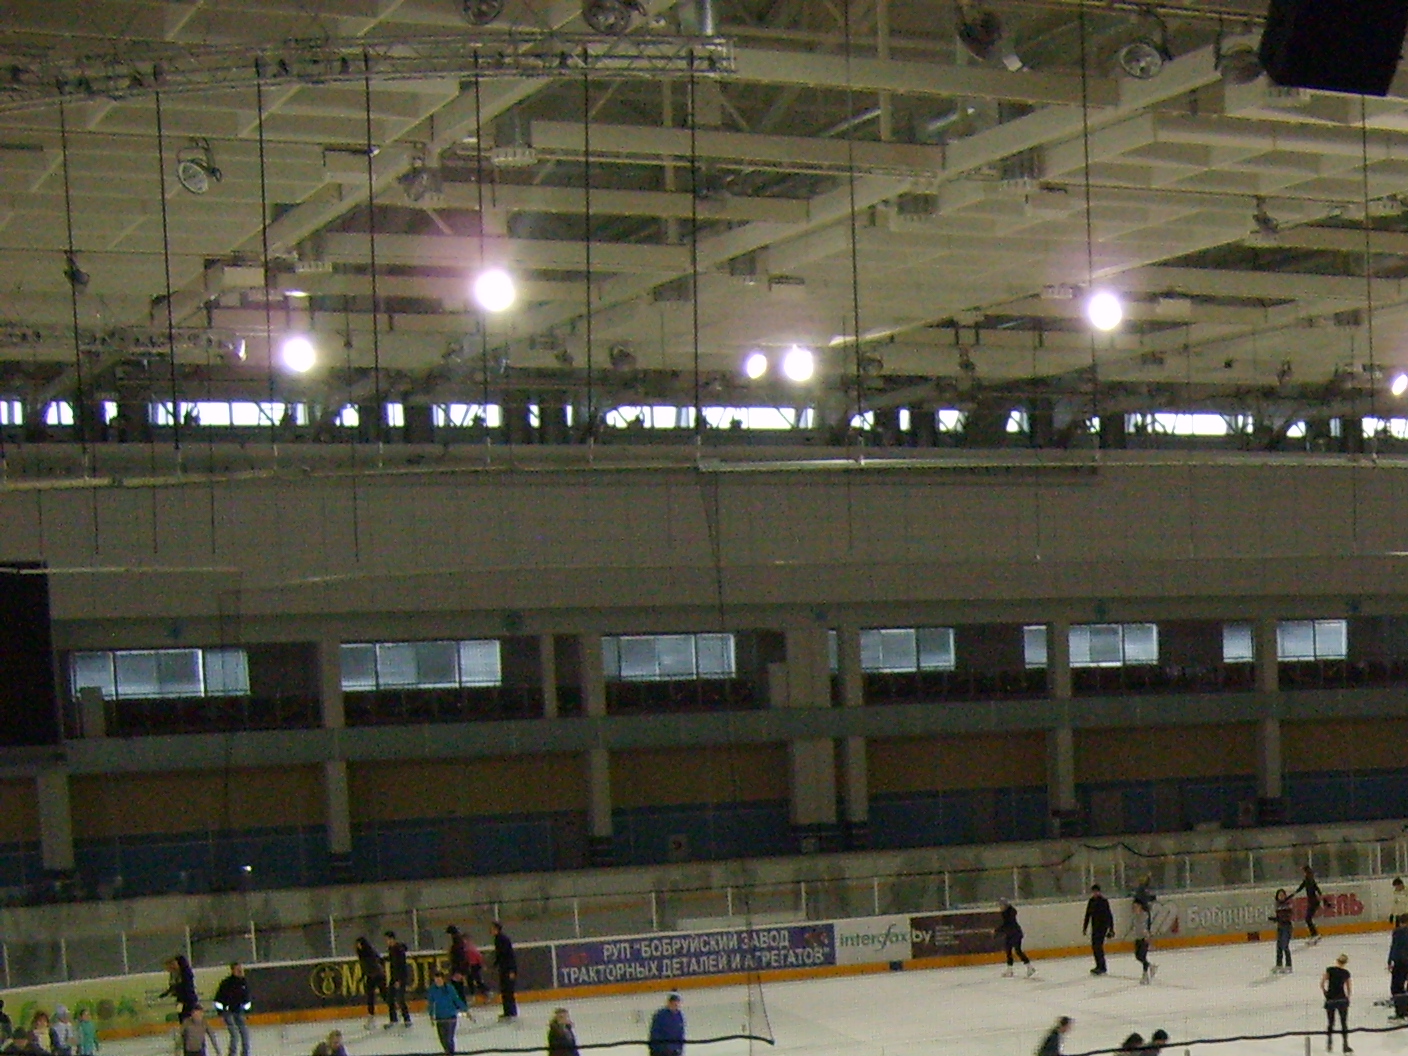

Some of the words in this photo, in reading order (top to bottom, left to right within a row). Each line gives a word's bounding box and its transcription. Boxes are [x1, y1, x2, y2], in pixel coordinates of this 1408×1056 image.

[602, 943, 631, 961] РУП
[740, 929, 790, 949] ЗАВОД
[562, 960, 660, 985] ТРАКТОРНЫХ
[661, 953, 729, 979] ДЕТАЛЕЙ
[730, 953, 741, 969] И
